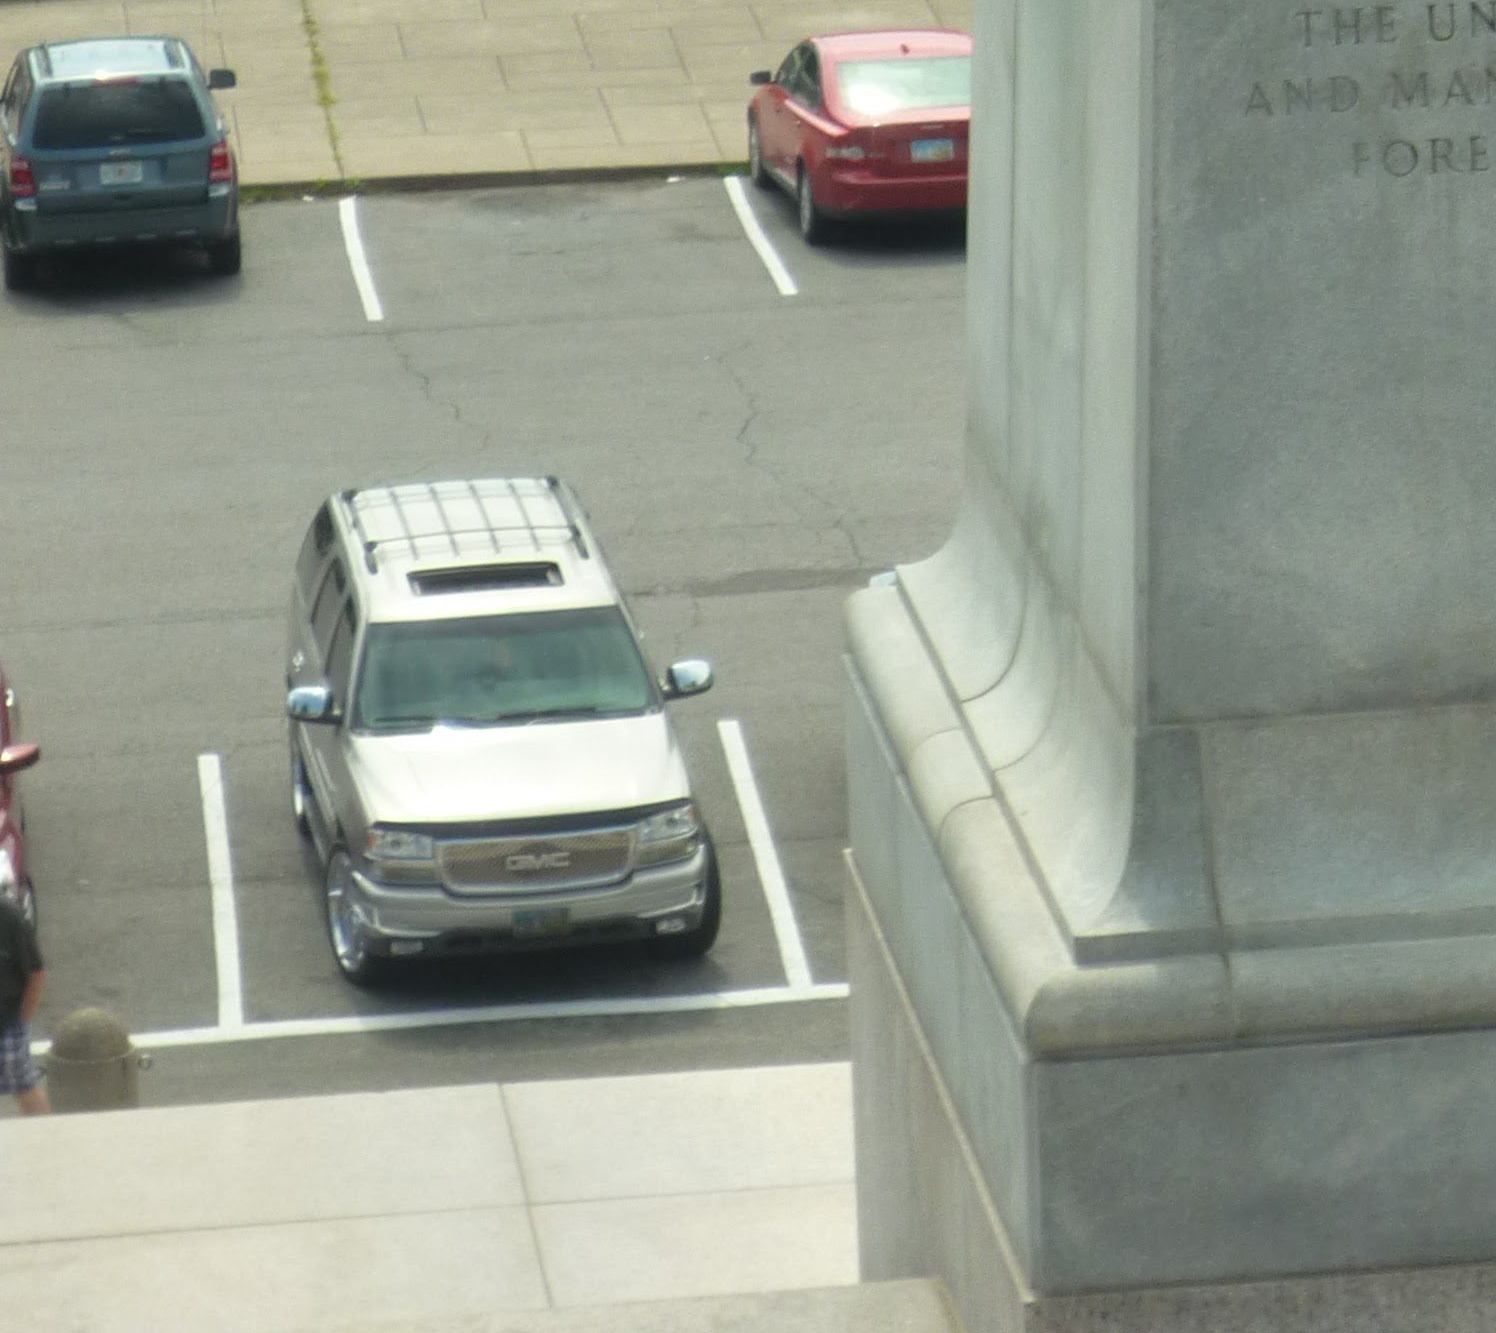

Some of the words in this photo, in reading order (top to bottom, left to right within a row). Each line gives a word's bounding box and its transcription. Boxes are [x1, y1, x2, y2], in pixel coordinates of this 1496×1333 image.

[1296, 5, 1398, 47] THE
[1246, 75, 1360, 116] AND
[506, 852, 571, 870] GMC
